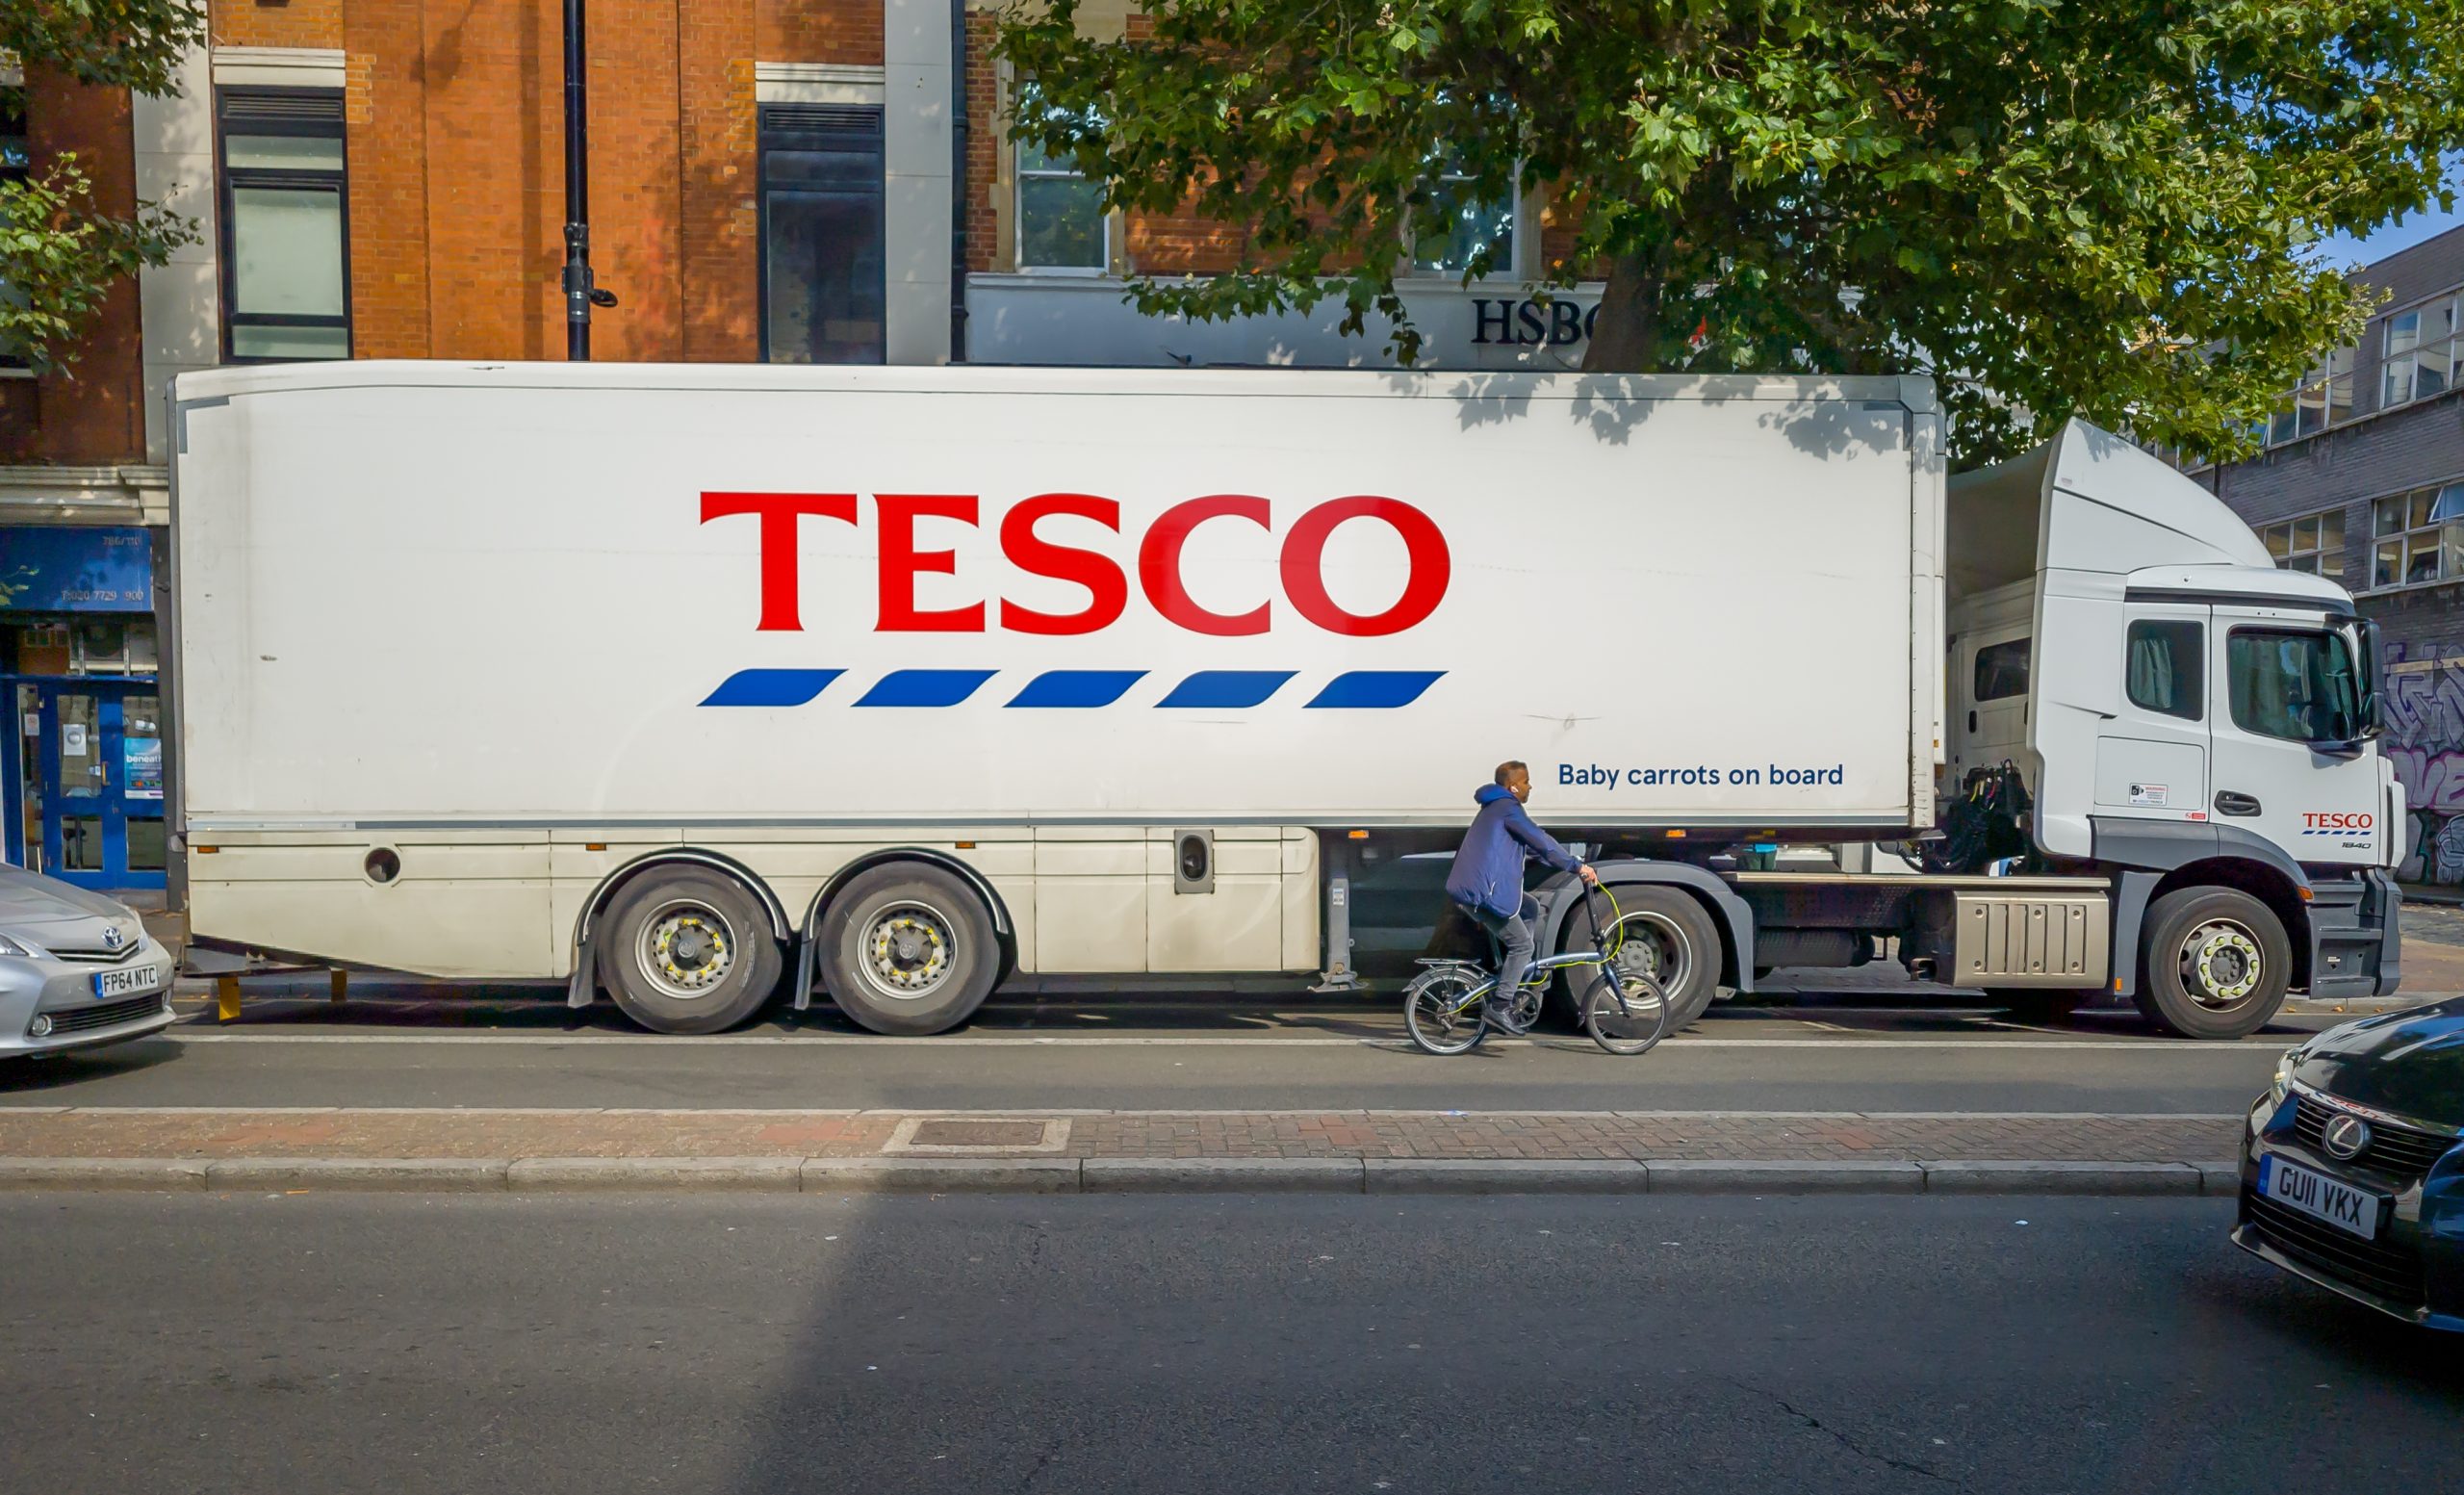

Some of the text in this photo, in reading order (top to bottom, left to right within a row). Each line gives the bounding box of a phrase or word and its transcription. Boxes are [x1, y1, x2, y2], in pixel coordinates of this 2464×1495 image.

[701, 492, 1450, 637] TESCO
[93, 590, 116, 601] 7729
[1558, 764, 1843, 790] Baby carrots on board
[2302, 812, 2373, 828] TESCO
[104, 967, 156, 992] FP64 NTC
[2279, 1167, 2364, 1226] GU11 VKX
